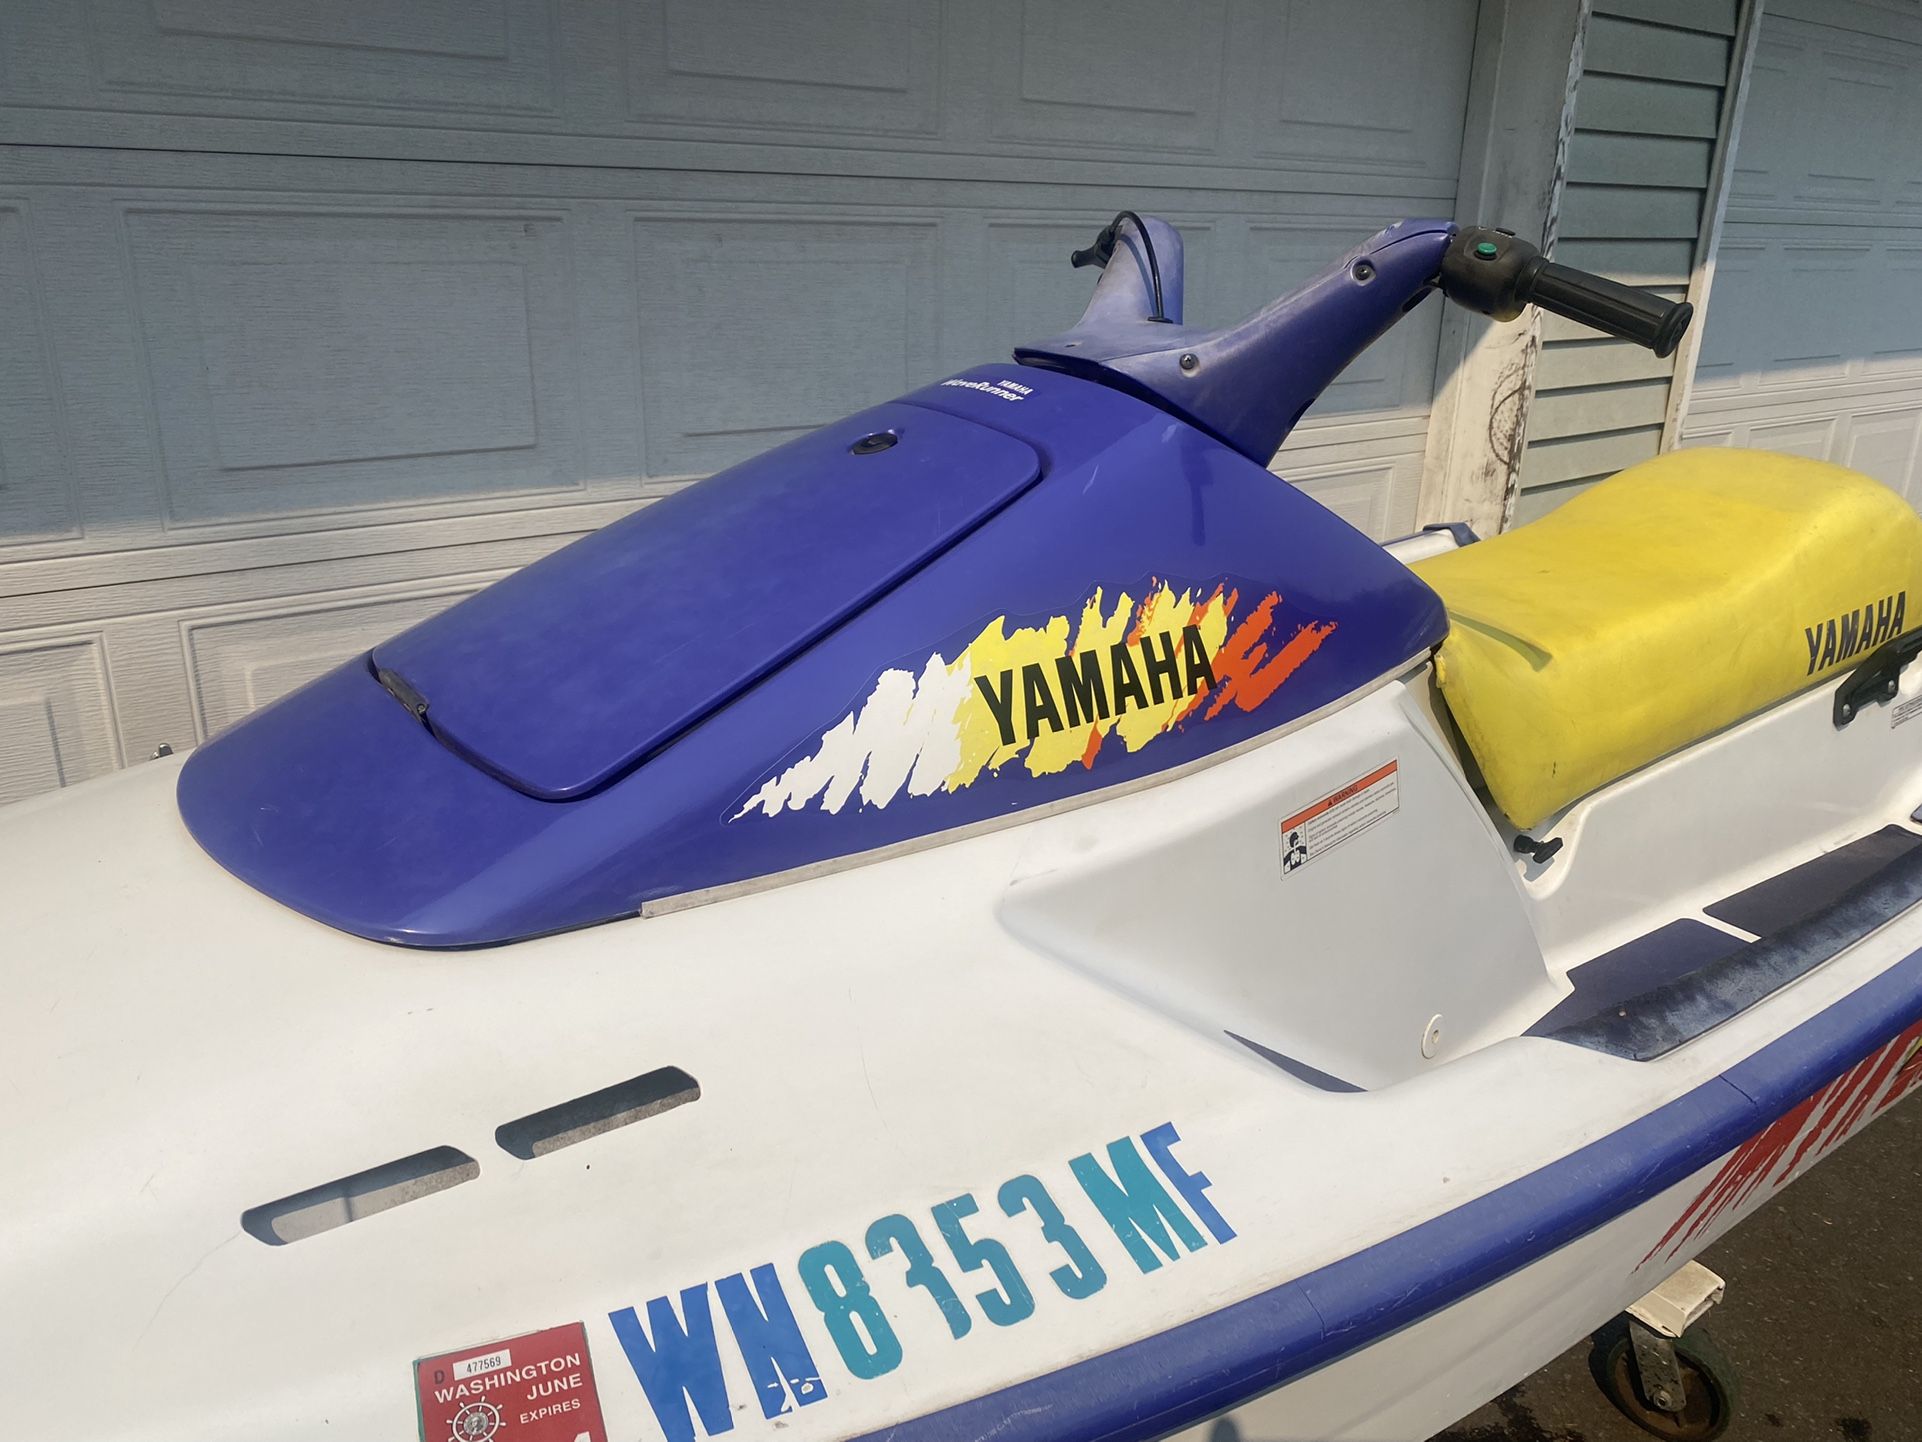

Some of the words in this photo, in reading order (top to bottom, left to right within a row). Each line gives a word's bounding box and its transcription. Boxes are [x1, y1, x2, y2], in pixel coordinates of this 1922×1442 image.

[997, 380, 1033, 395] YAMAHA
[1805, 591, 1906, 676] YAMAHA
[974, 624, 1218, 746] YAMAHA
[1068, 1122, 1238, 1275] MF
[434, 1370, 445, 1384] D
[467, 1356, 501, 1373] 477569
[434, 1353, 581, 1403] WASHINGTON
[527, 1373, 583, 1400] JUNE
[520, 1399, 581, 1424] EXPIRES
